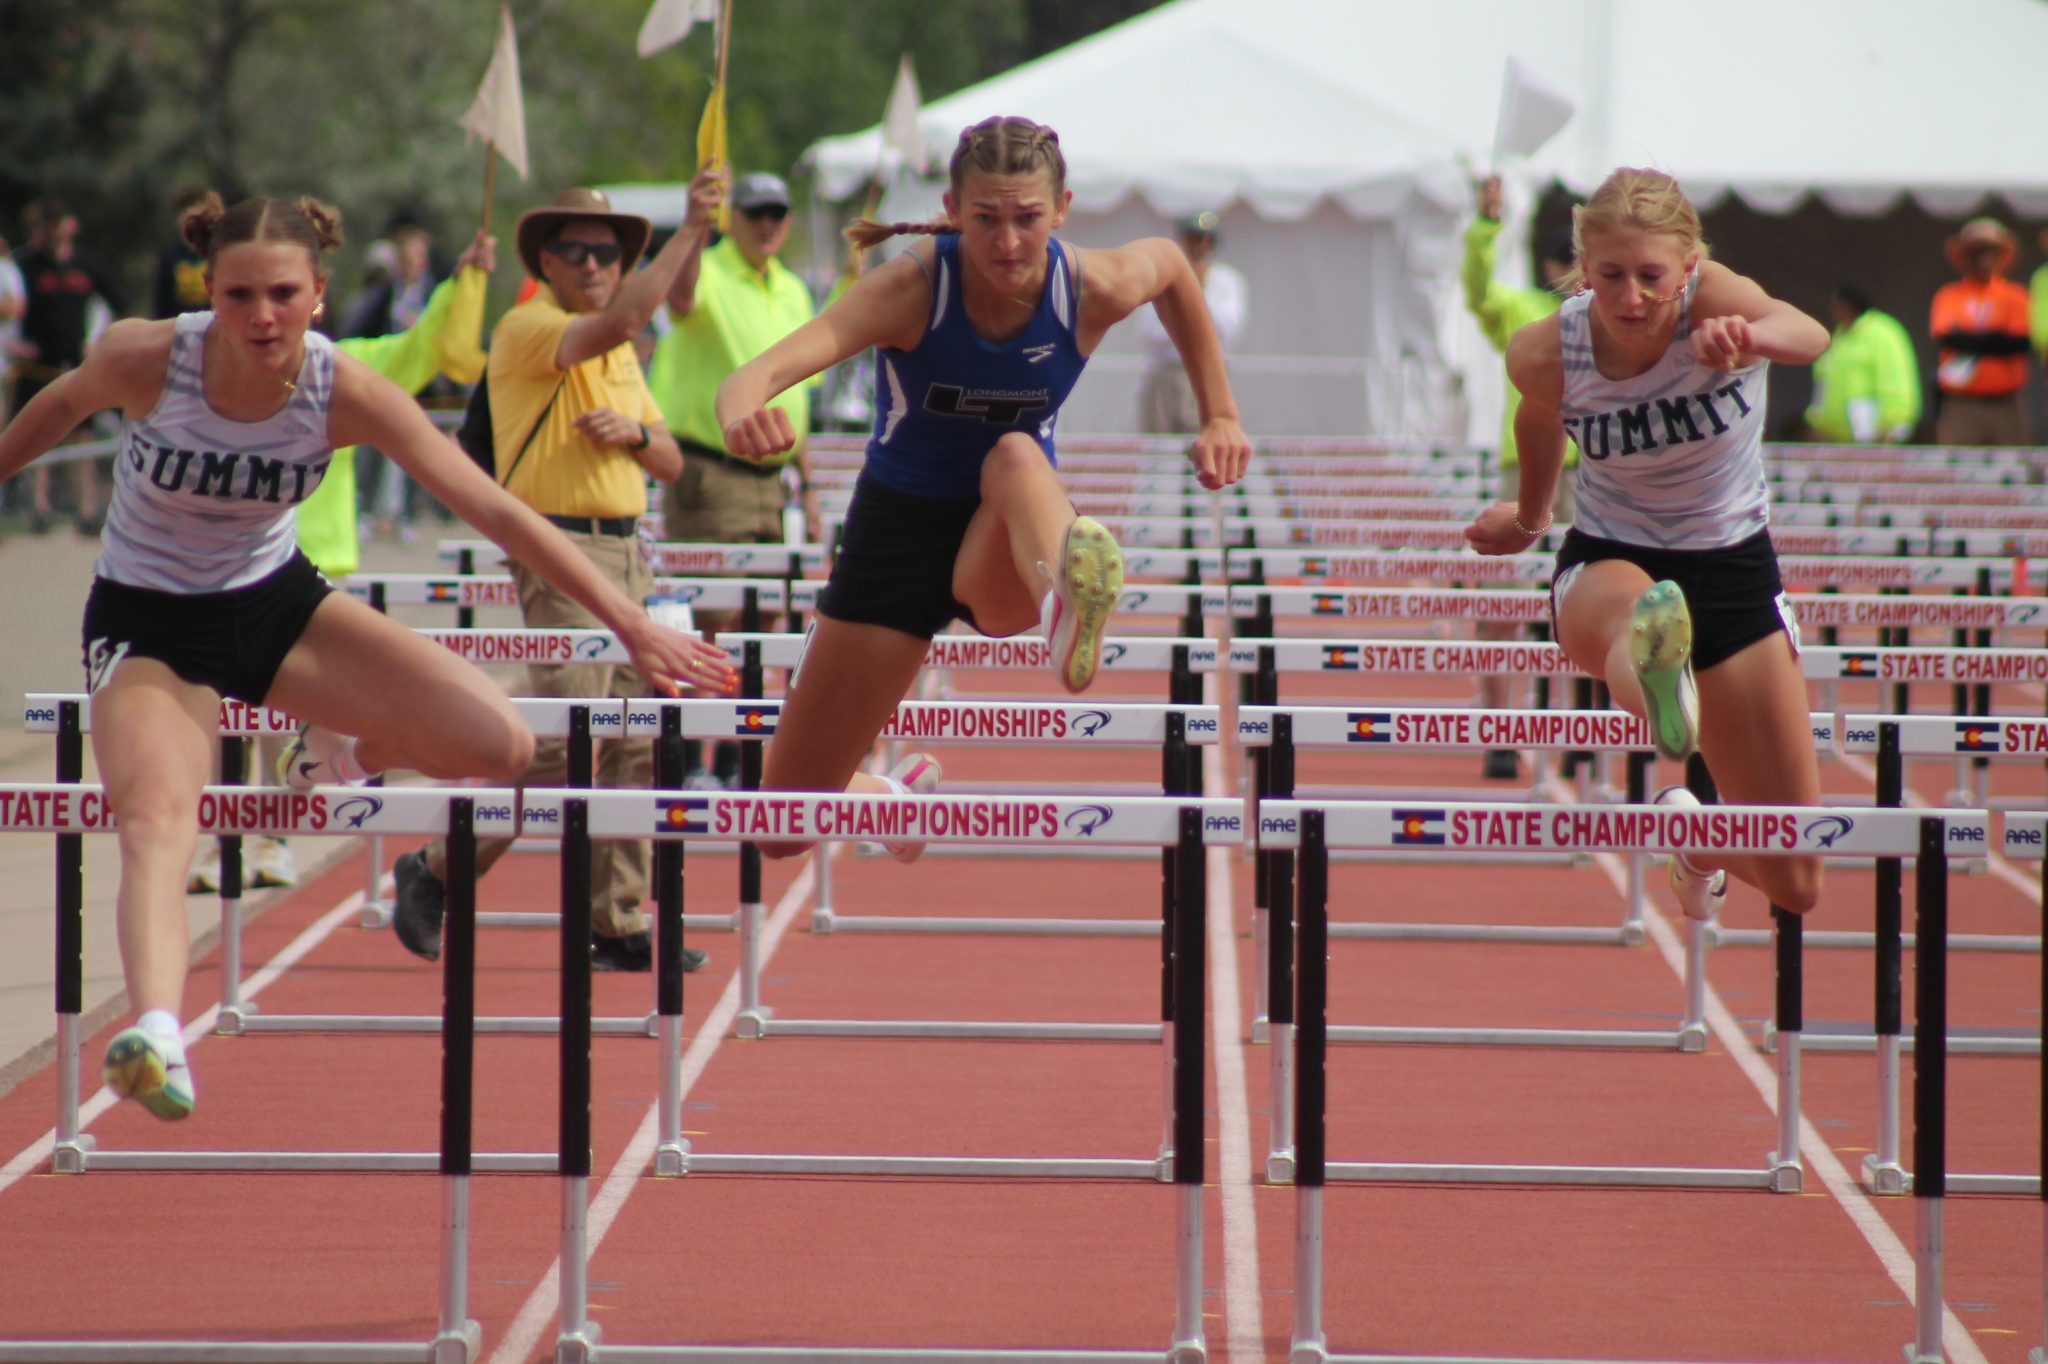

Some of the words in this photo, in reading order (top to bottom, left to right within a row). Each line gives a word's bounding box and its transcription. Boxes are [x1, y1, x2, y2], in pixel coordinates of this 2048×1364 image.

[966, 388, 1049, 397] LONGMONT
[1363, 527, 1467, 546] CHAMPIONSHI
[1331, 558, 1378, 577] STATE
[1384, 559, 1515, 580] CHAMPIONSHIPS
[1348, 595, 1401, 615] STATE
[1407, 596, 1554, 619] CHAMPIONSHIPS
[1795, 602, 1850, 624] STATE
[1855, 603, 2006, 627] CHAMPIONSHIPS
[434, 635, 572, 660] MPIONSHIPS
[923, 642, 1053, 667] HAMPIONSH
[1363, 646, 1426, 670] STATE
[1432, 647, 1578, 672] CHAMPIONSH
[1881, 654, 1945, 678] STATE
[1952, 655, 2048, 679] CHAMPIO
[218, 701, 259, 731] ATE
[883, 707, 1068, 738] HAMPIONSHIPS
[1396, 714, 1470, 744] STATE
[1477, 714, 1654, 746] CHAMPIONSHI
[2004, 722, 2048, 753] STA
[0, 790, 71, 826] TATE
[78, 791, 328, 830] CHONSHIPS
[714, 798, 805, 834] STATE
[813, 799, 1058, 838] CHAMPIONSHIPS
[1450, 809, 1543, 847] STATE
[1550, 810, 1798, 850] CHAMPIONSHIPS
